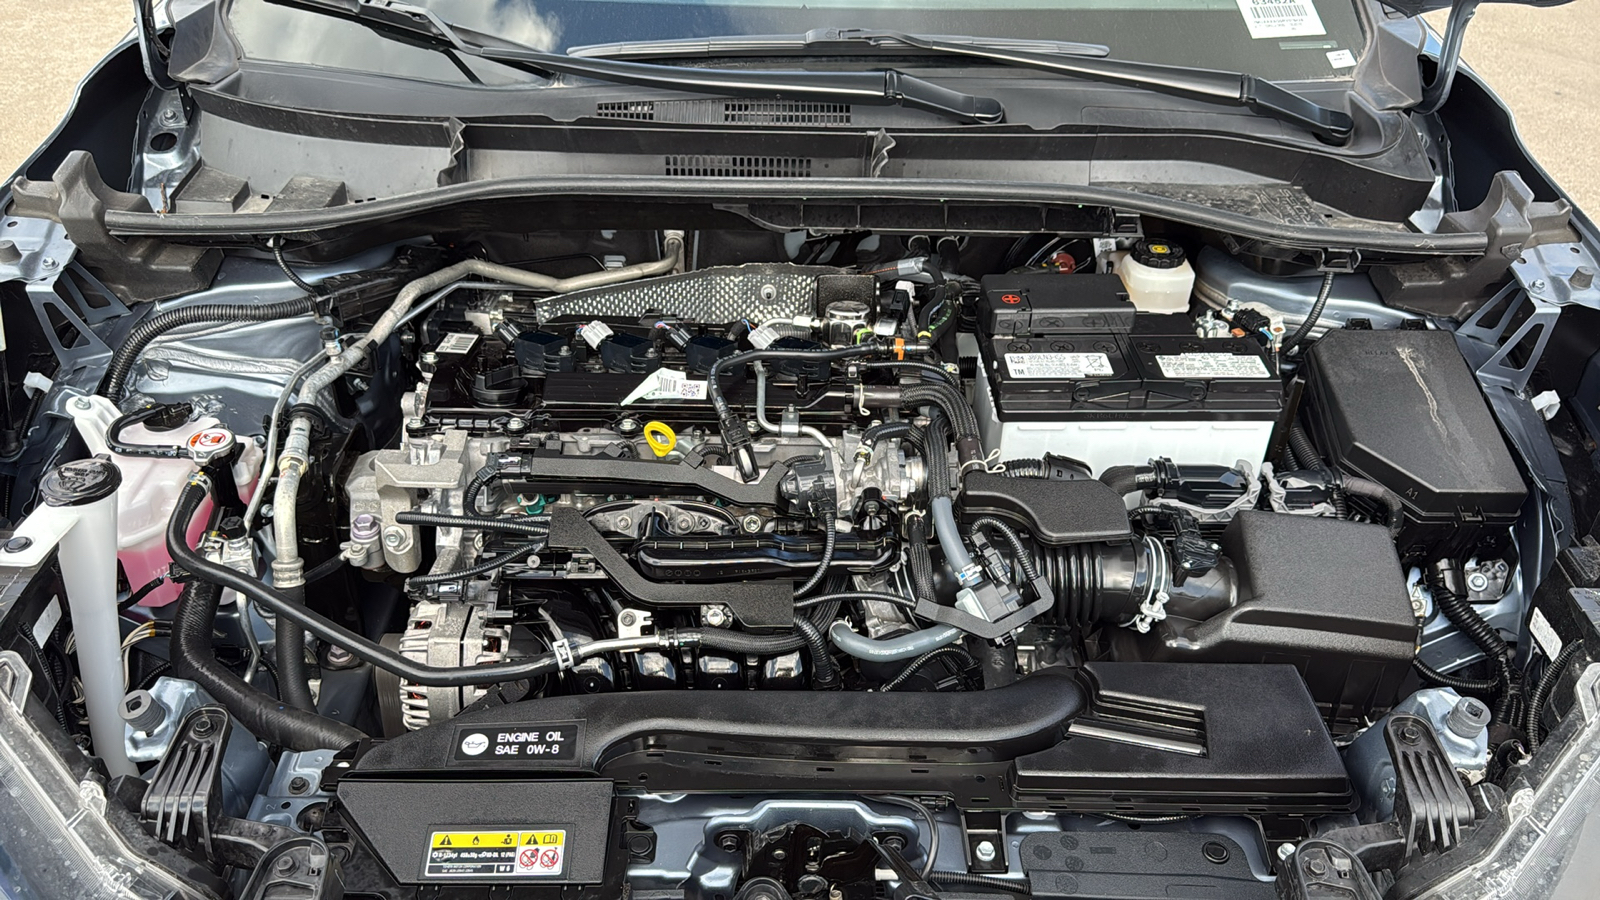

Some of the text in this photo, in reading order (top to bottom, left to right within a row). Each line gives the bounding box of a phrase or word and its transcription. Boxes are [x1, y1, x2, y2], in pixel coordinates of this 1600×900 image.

[496, 731, 565, 743] ENGINE OIL
[494, 744, 560, 755] SAE 0W-8
